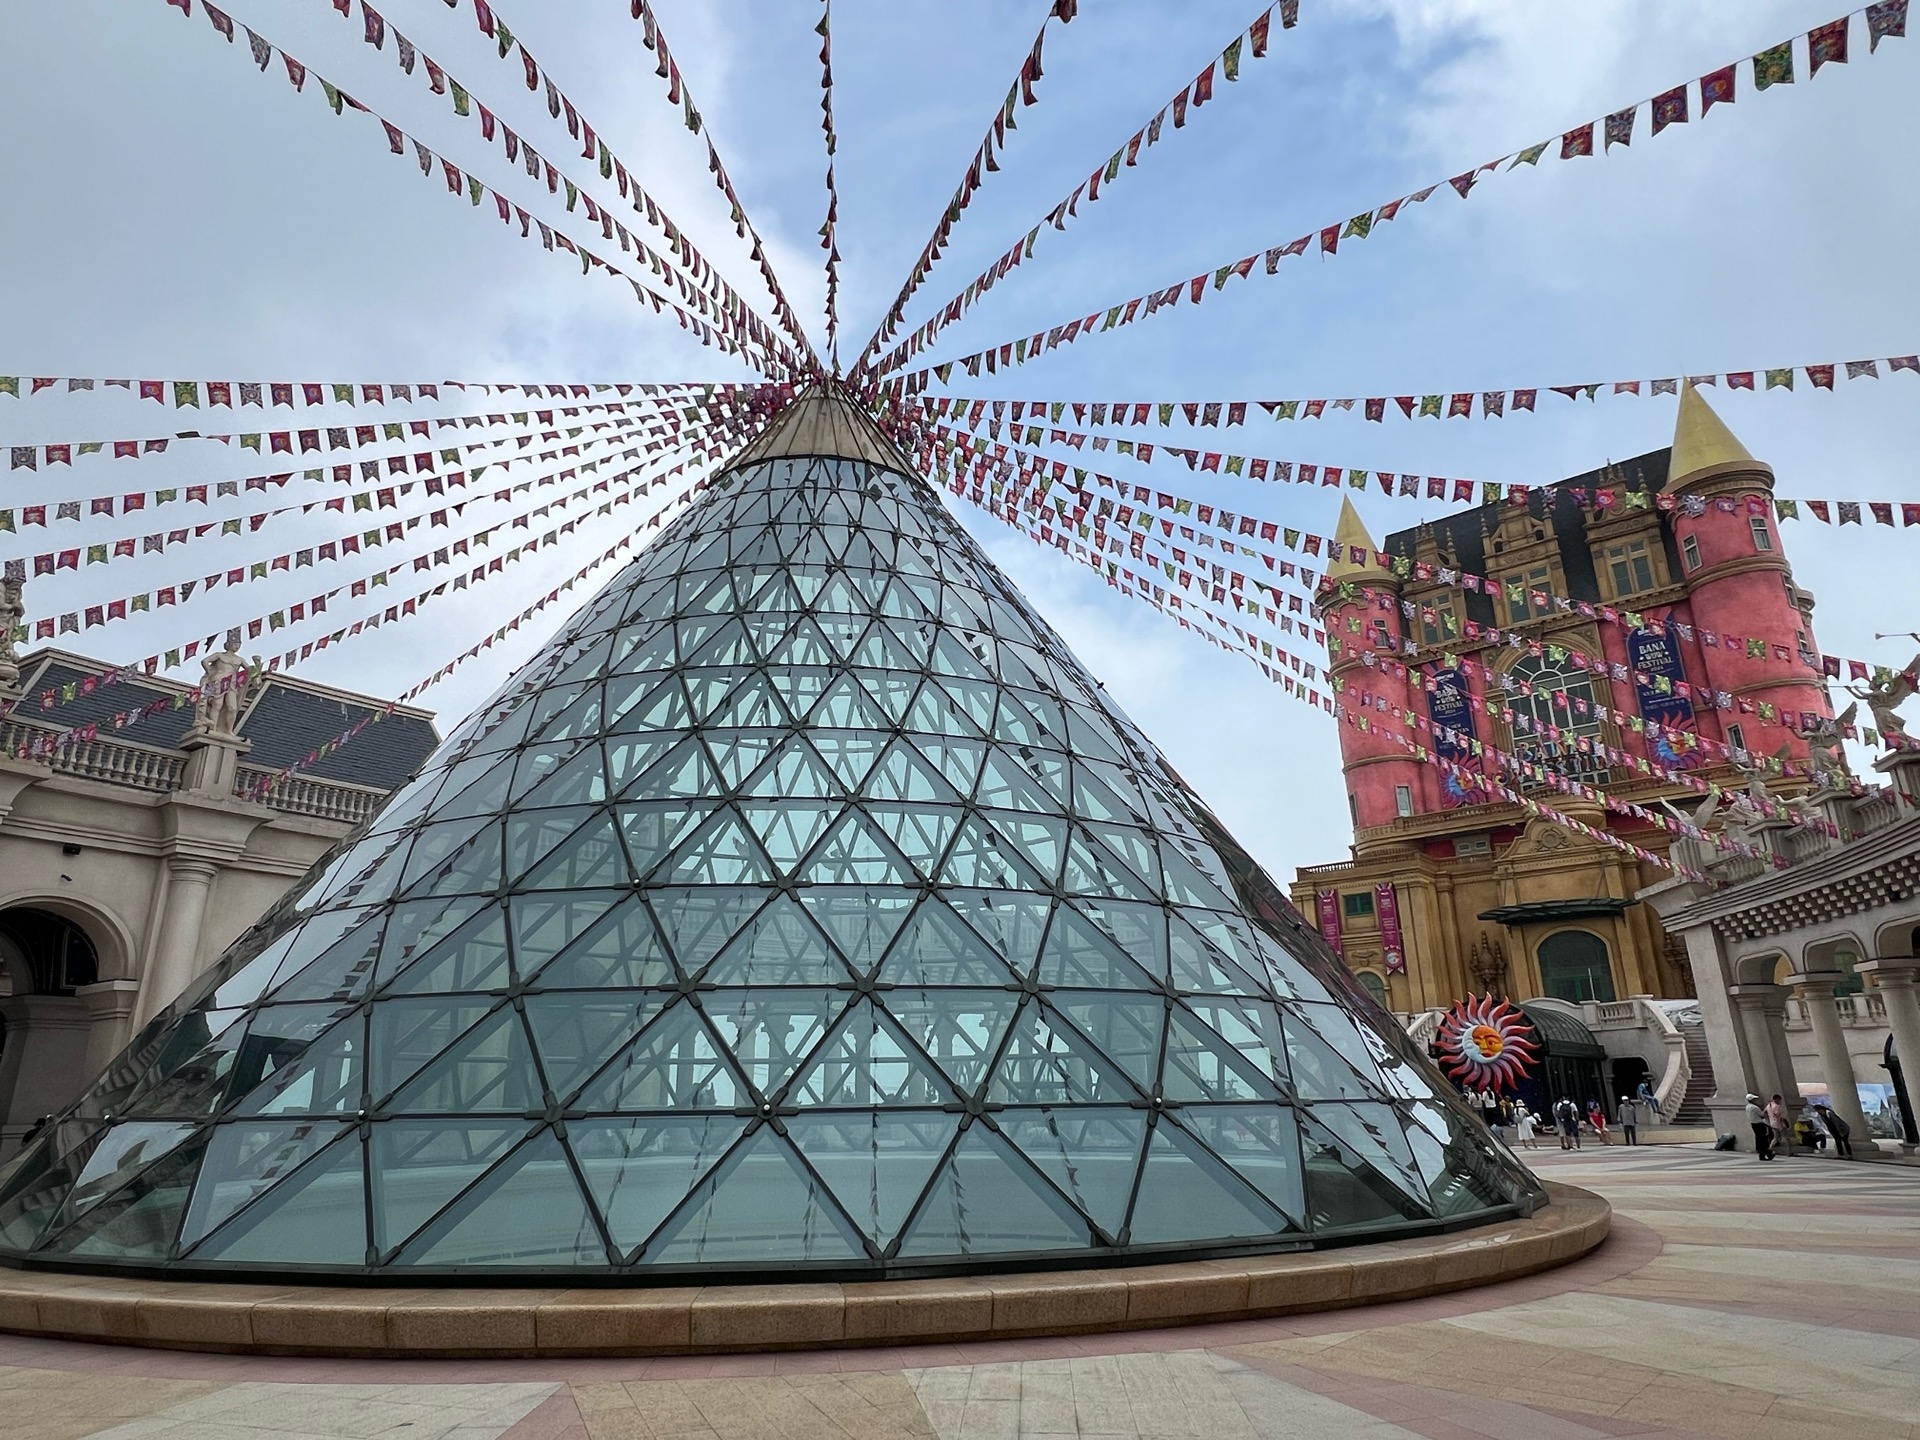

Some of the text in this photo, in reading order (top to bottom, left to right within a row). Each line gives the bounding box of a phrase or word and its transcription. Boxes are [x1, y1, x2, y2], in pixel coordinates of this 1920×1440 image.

[1639, 641, 1665, 654] BANA
[1638, 657, 1673, 669] FESTIVAL
[1435, 701, 1463, 711] FESTIVAL
